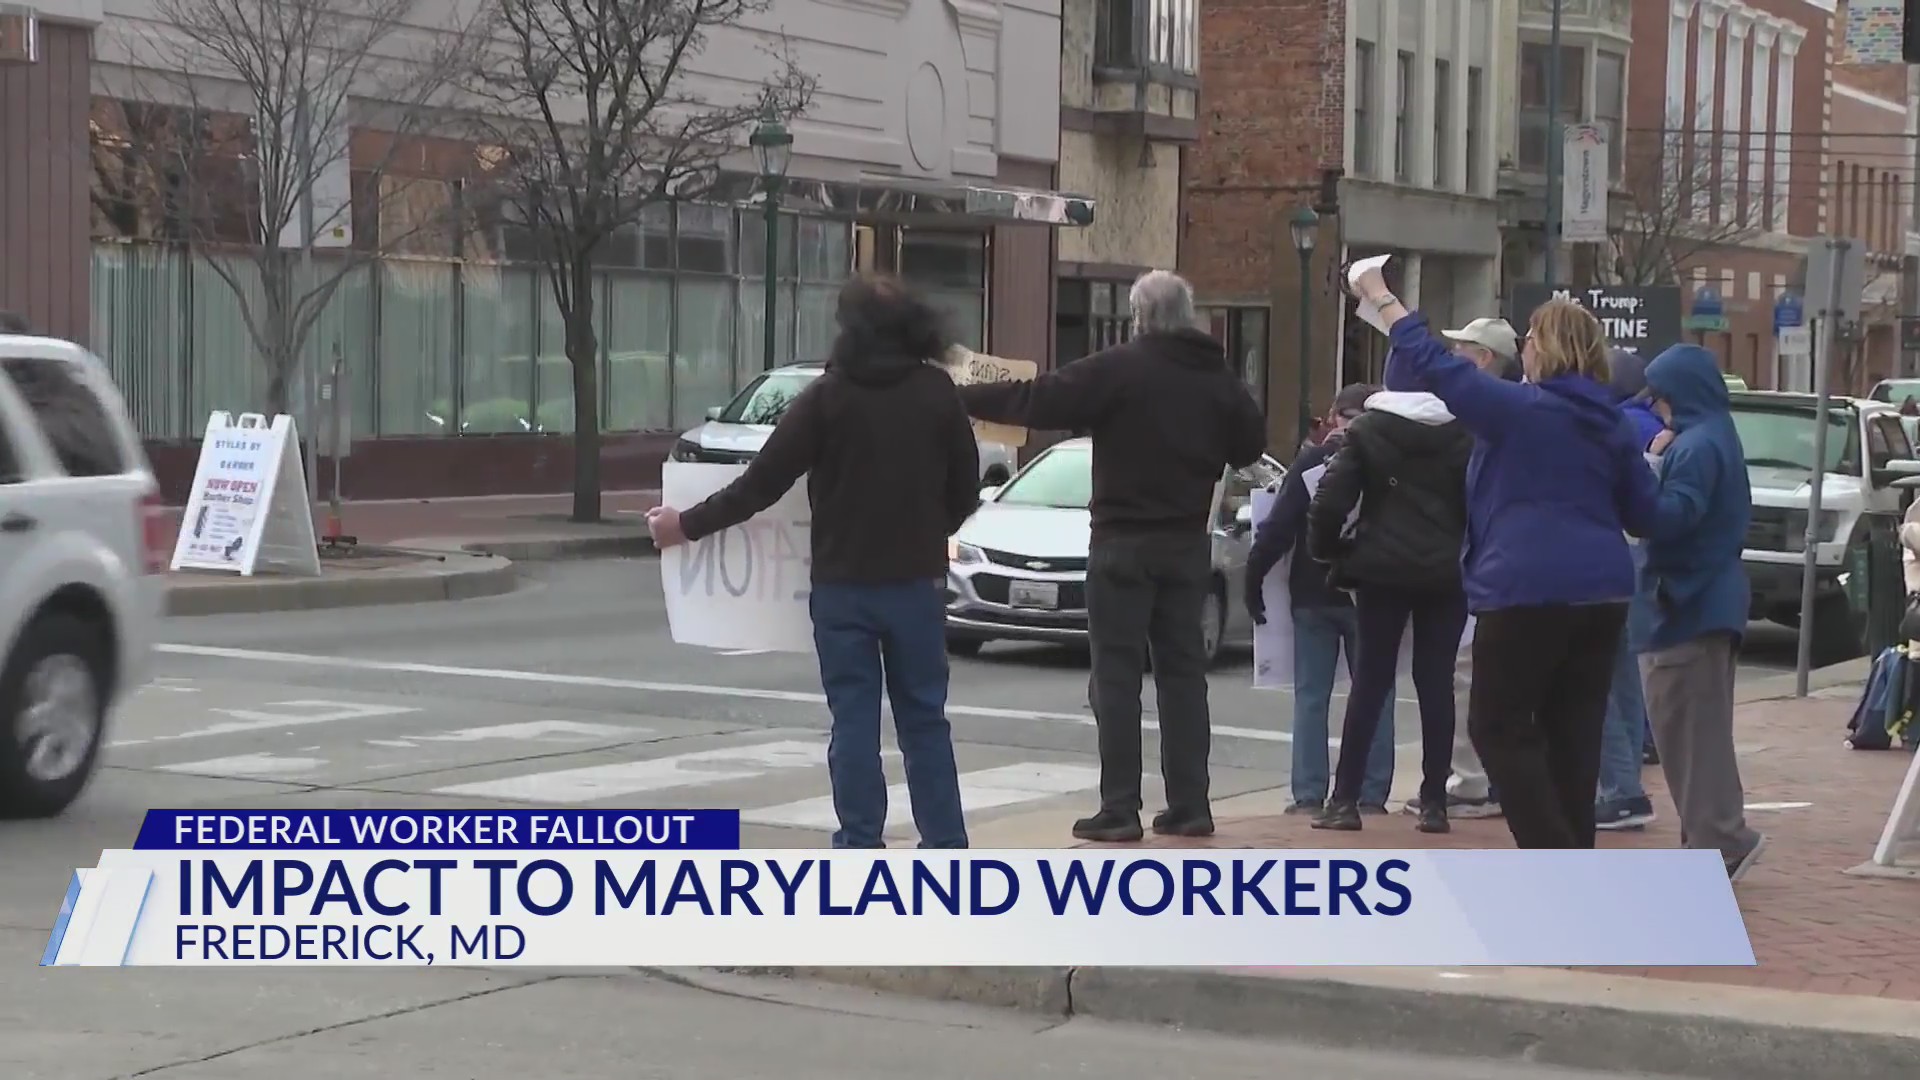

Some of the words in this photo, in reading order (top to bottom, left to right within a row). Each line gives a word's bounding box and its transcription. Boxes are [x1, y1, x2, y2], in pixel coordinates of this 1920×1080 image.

[1588, 289, 1644, 314] Trump:
[206, 479, 230, 490] NOW
[230, 480, 258, 492] OPEN
[203, 491, 231, 502] Barber
[232, 494, 254, 505] Shop
